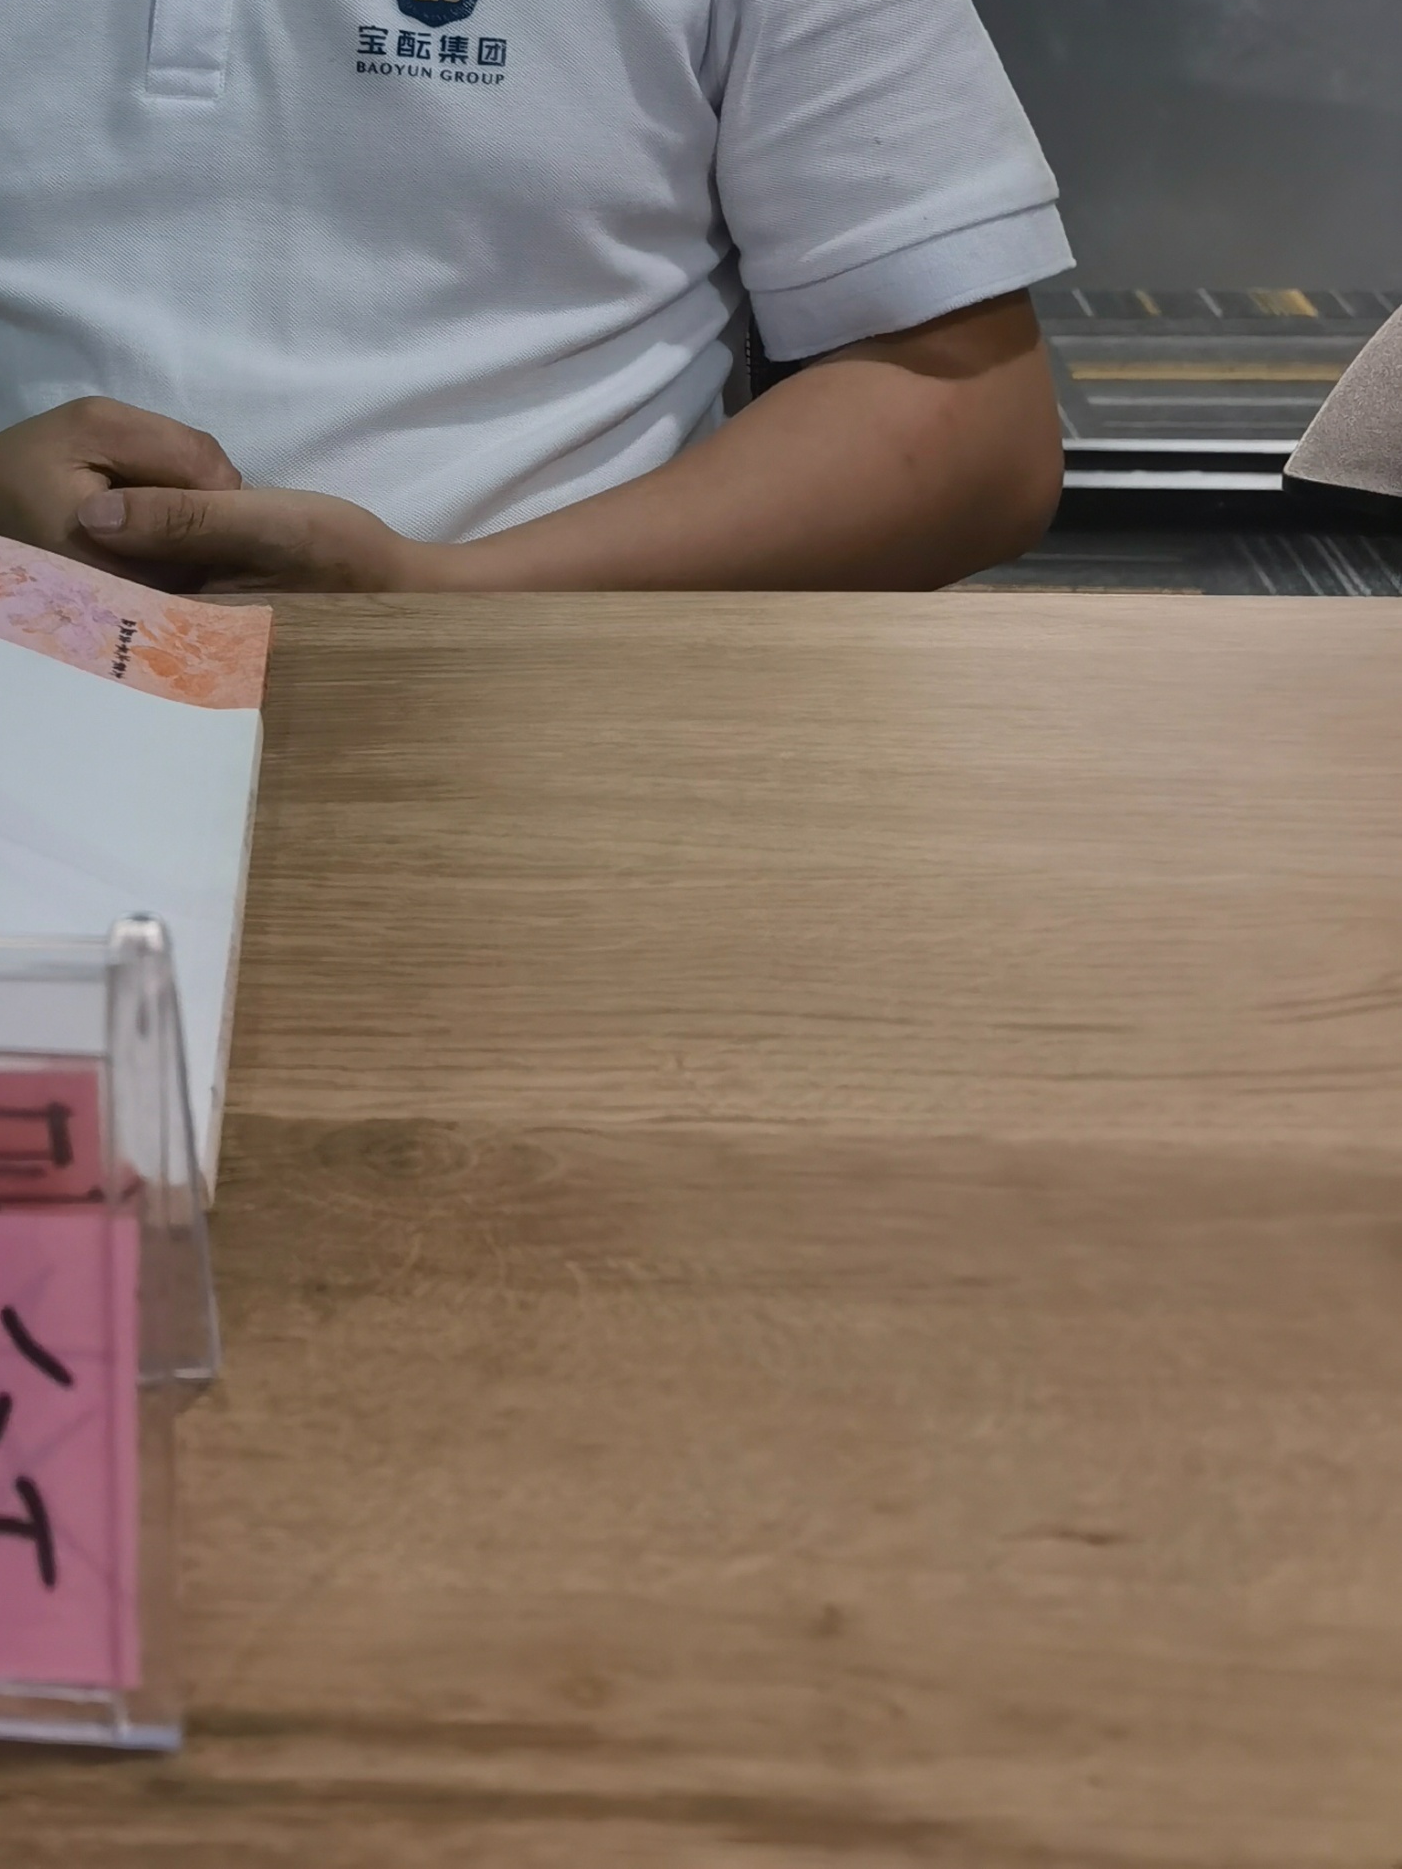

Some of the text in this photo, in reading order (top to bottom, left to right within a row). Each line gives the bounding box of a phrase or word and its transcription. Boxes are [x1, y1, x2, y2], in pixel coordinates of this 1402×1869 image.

[356, 25, 507, 68] 宝酝集团
[356, 60, 506, 85] BAOYUN GROUP
